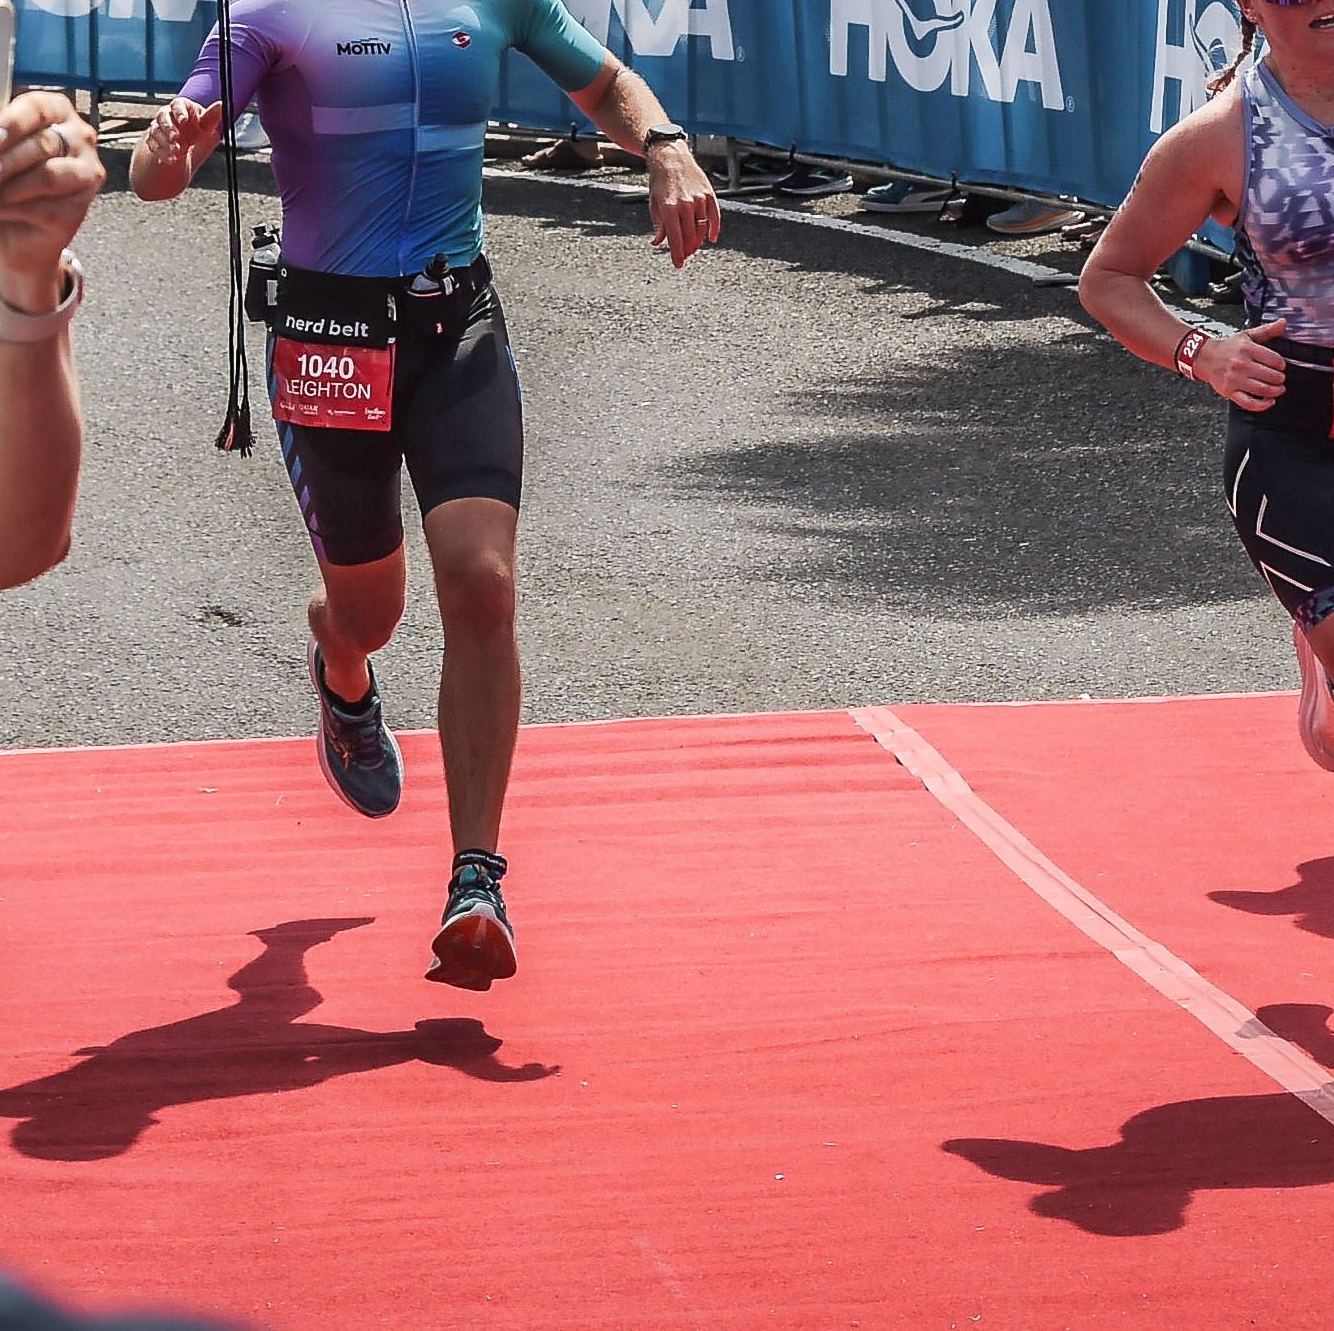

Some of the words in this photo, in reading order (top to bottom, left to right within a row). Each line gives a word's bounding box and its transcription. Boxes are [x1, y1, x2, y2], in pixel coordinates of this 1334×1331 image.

[285, 314, 326, 334] nerd
[328, 319, 369, 338] belt
[297, 353, 355, 380] 1040
[285, 378, 372, 400] LEIGHTON
